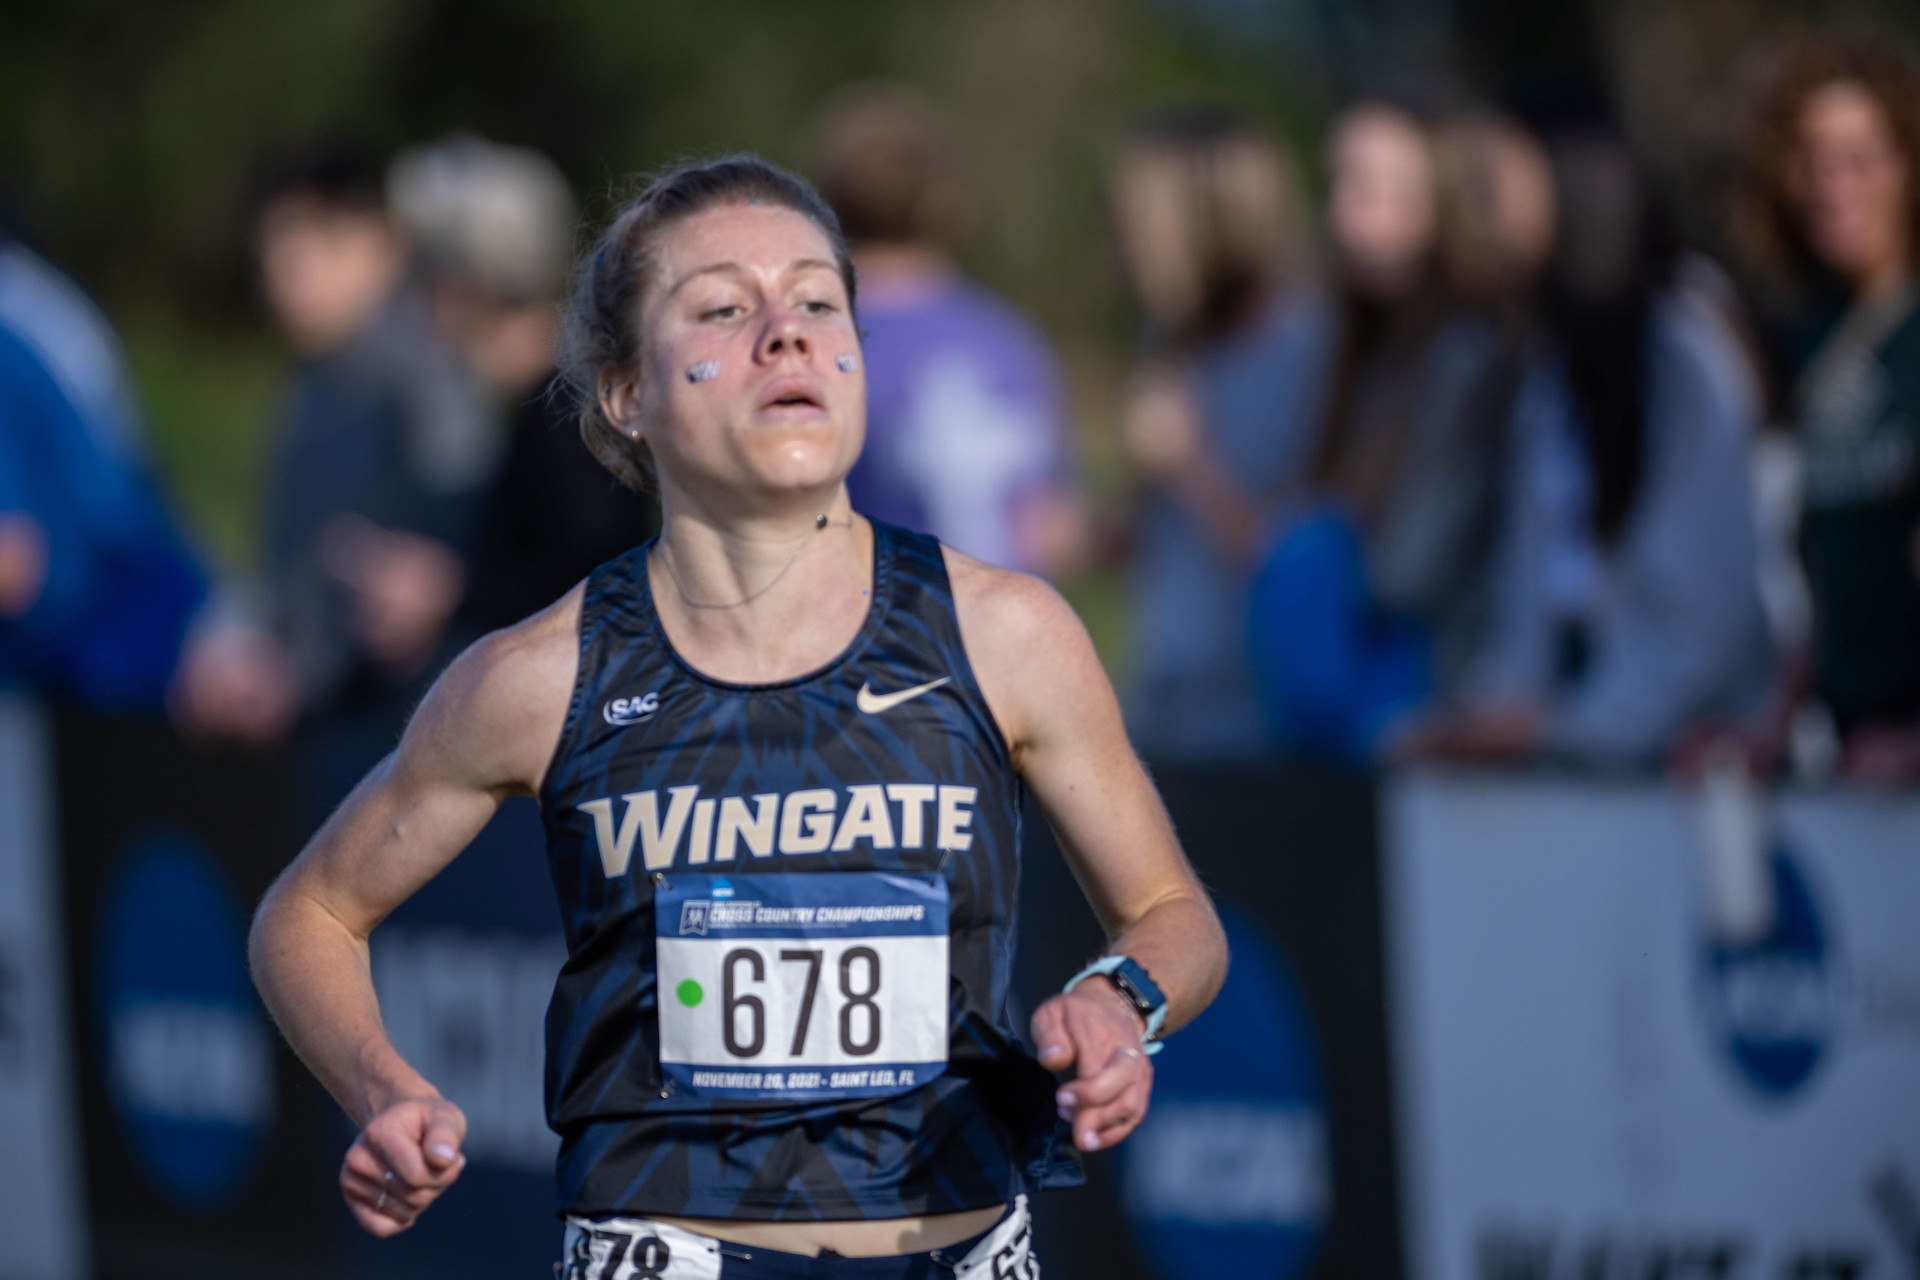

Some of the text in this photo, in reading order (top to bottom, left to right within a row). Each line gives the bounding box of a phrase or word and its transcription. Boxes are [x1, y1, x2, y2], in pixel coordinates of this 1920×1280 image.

[611, 691, 660, 719] SAC
[576, 783, 979, 879] WINGATE
[709, 907, 754, 922] CROSS
[755, 906, 815, 923] COUNTRY
[816, 905, 925, 922] CHAMPIONSHIPS
[722, 945, 882, 1058] 678
[692, 1071, 762, 1089] NOVEMBER
[830, 1070, 869, 1088] SAINT
[898, 1068, 915, 1086] FL
